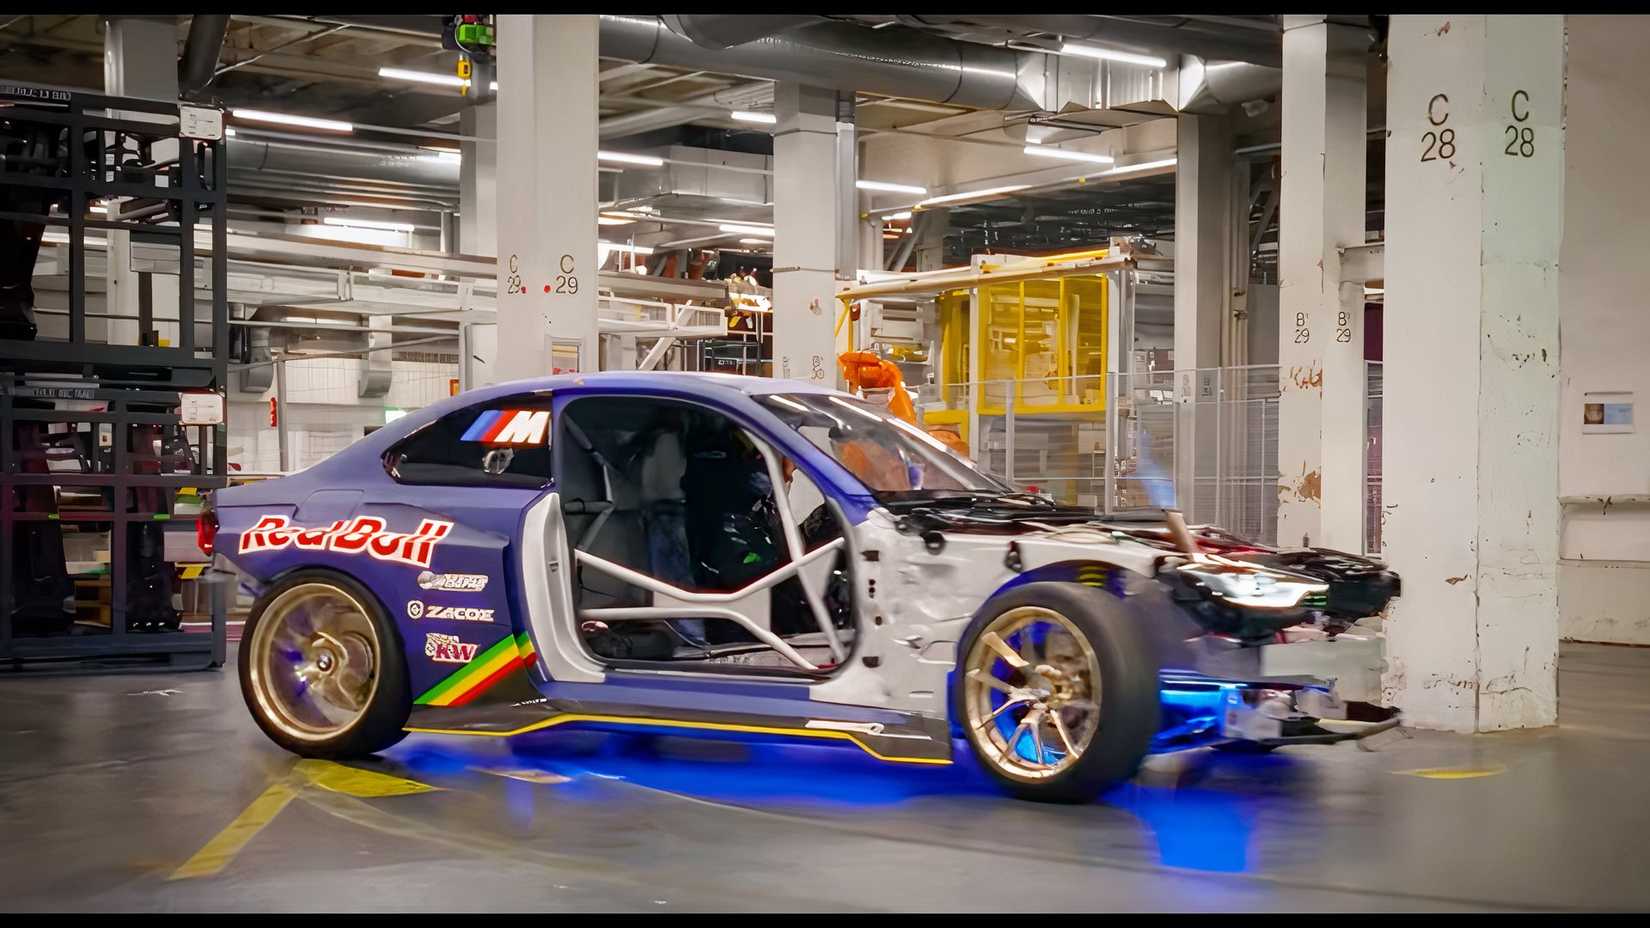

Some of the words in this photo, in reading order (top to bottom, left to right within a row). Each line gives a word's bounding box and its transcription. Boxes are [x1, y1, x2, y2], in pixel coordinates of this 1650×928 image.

[1428, 93, 1449, 126] C
[1511, 89, 1529, 122] C
[1420, 128, 1456, 162] 28
[1504, 125, 1535, 158] 28
[509, 254, 519, 274] C
[560, 254, 575, 274] C
[507, 274, 521, 295] 29
[555, 275, 579, 295] 29
[1294, 327, 1310, 344] 29
[1336, 328, 1352, 343] 29
[493, 410, 551, 444] M
[432, 643, 477, 663] KW
